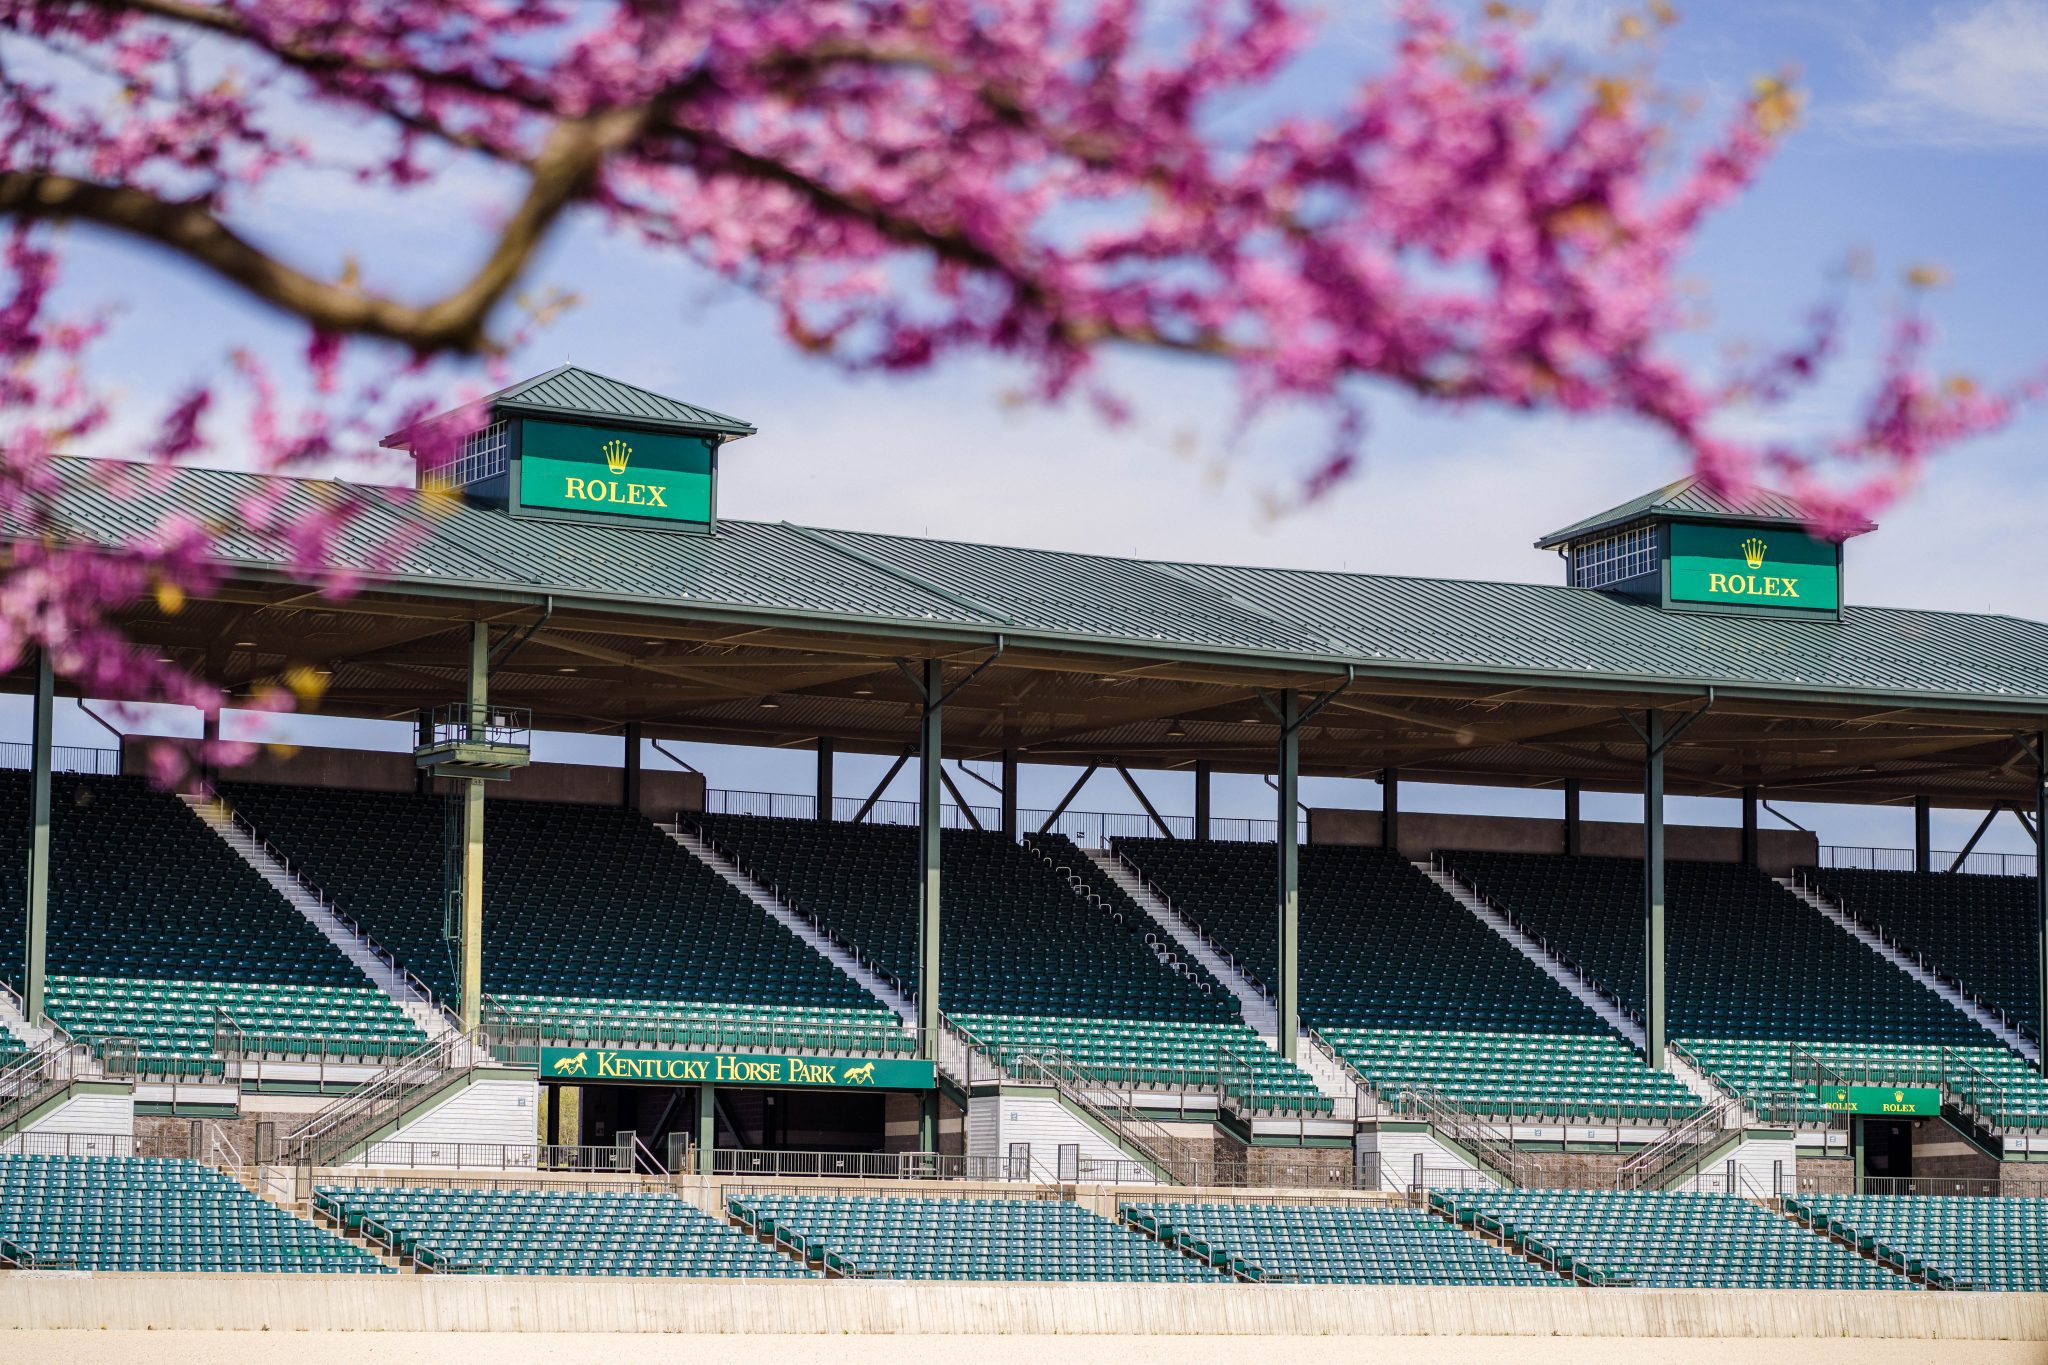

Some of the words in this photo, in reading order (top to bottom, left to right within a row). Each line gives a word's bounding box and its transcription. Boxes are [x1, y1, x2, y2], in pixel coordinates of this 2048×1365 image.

[565, 477, 668, 507] ROLEX
[1709, 573, 1800, 597] ROLEX
[597, 1052, 709, 1080] KENTUCKY
[716, 1056, 781, 1082] HORSE
[788, 1058, 836, 1083] PARK
[1883, 1103, 1915, 1112] ROLEX
